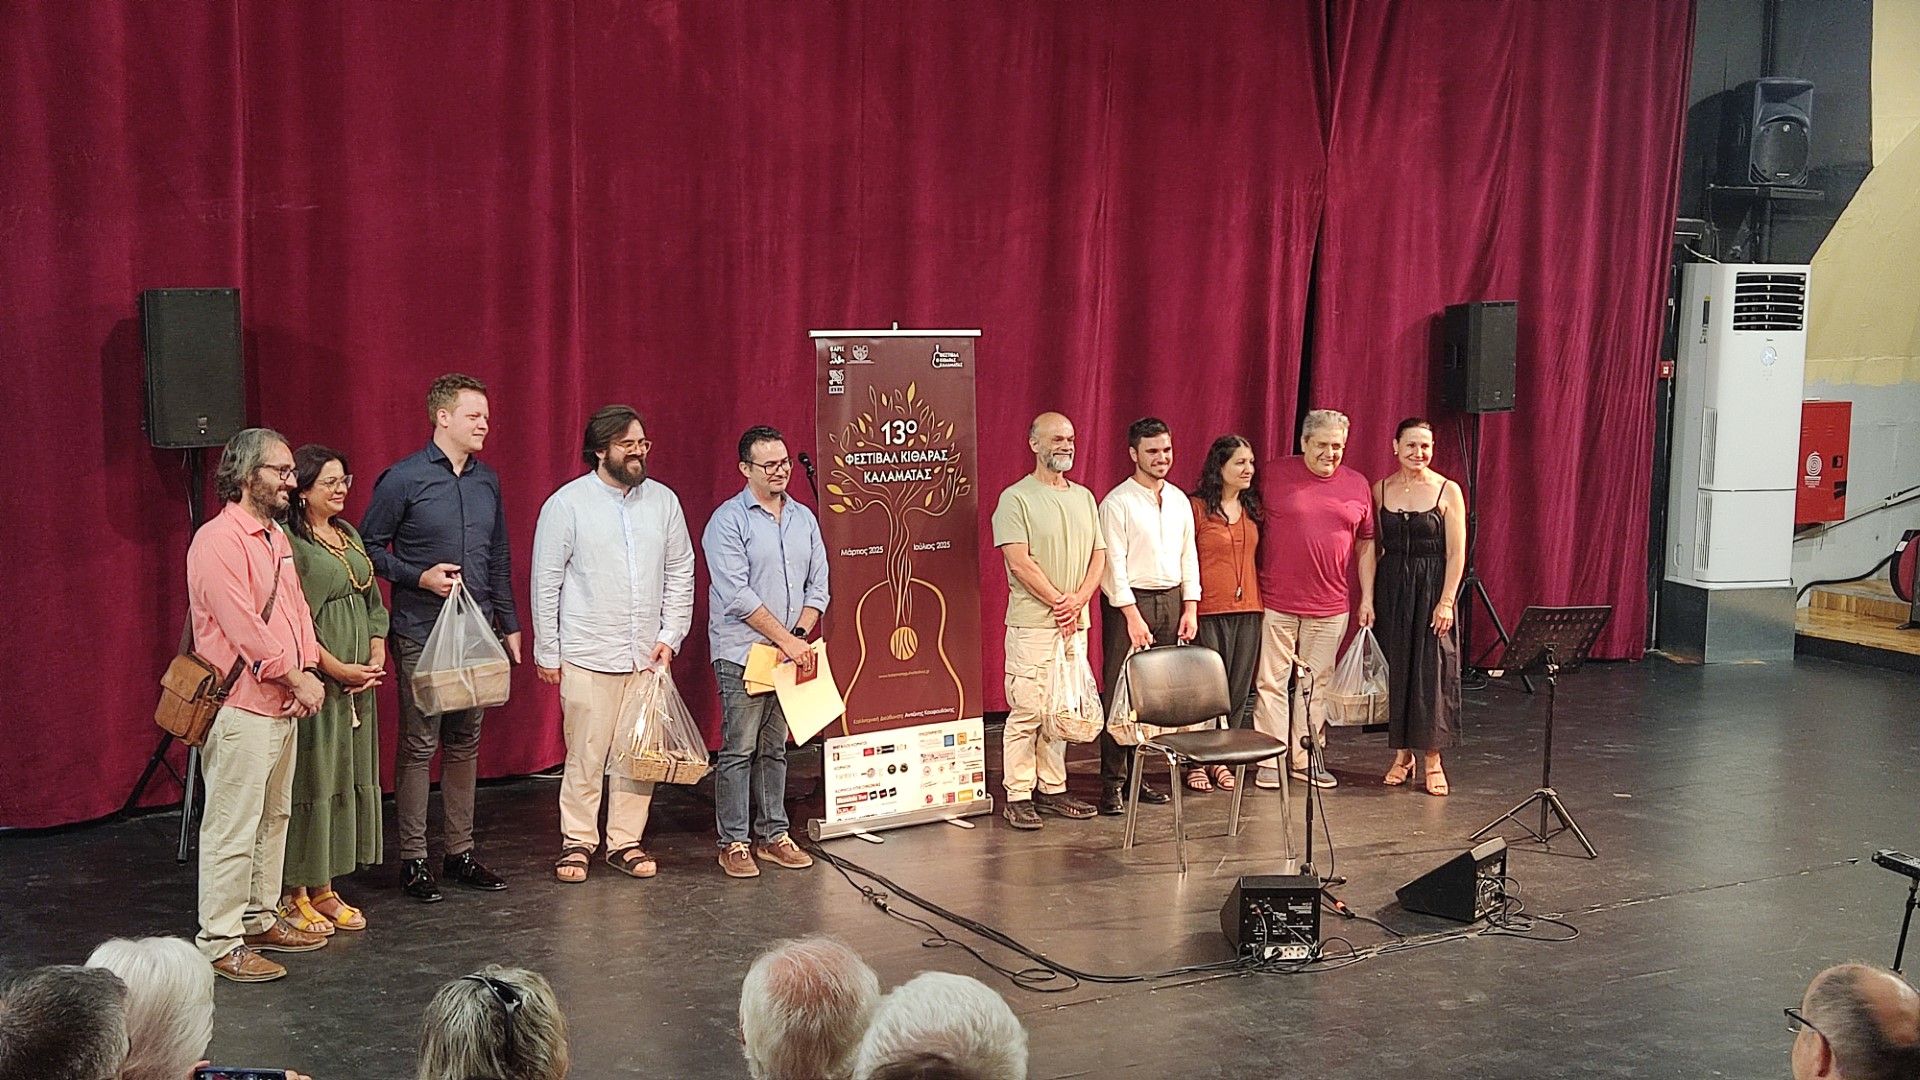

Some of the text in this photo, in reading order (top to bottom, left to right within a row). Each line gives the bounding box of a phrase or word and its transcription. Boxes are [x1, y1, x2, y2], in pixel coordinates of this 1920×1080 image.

[845, 450, 948, 465] ΦΕΣΤΙΒΑΛ ΚΙΘΑΡΑΣ
[864, 468, 932, 483] ΚΑΛΑΜΑΤΑΣ
[868, 545, 884, 554] 2025
[936, 541, 951, 549] 2025
